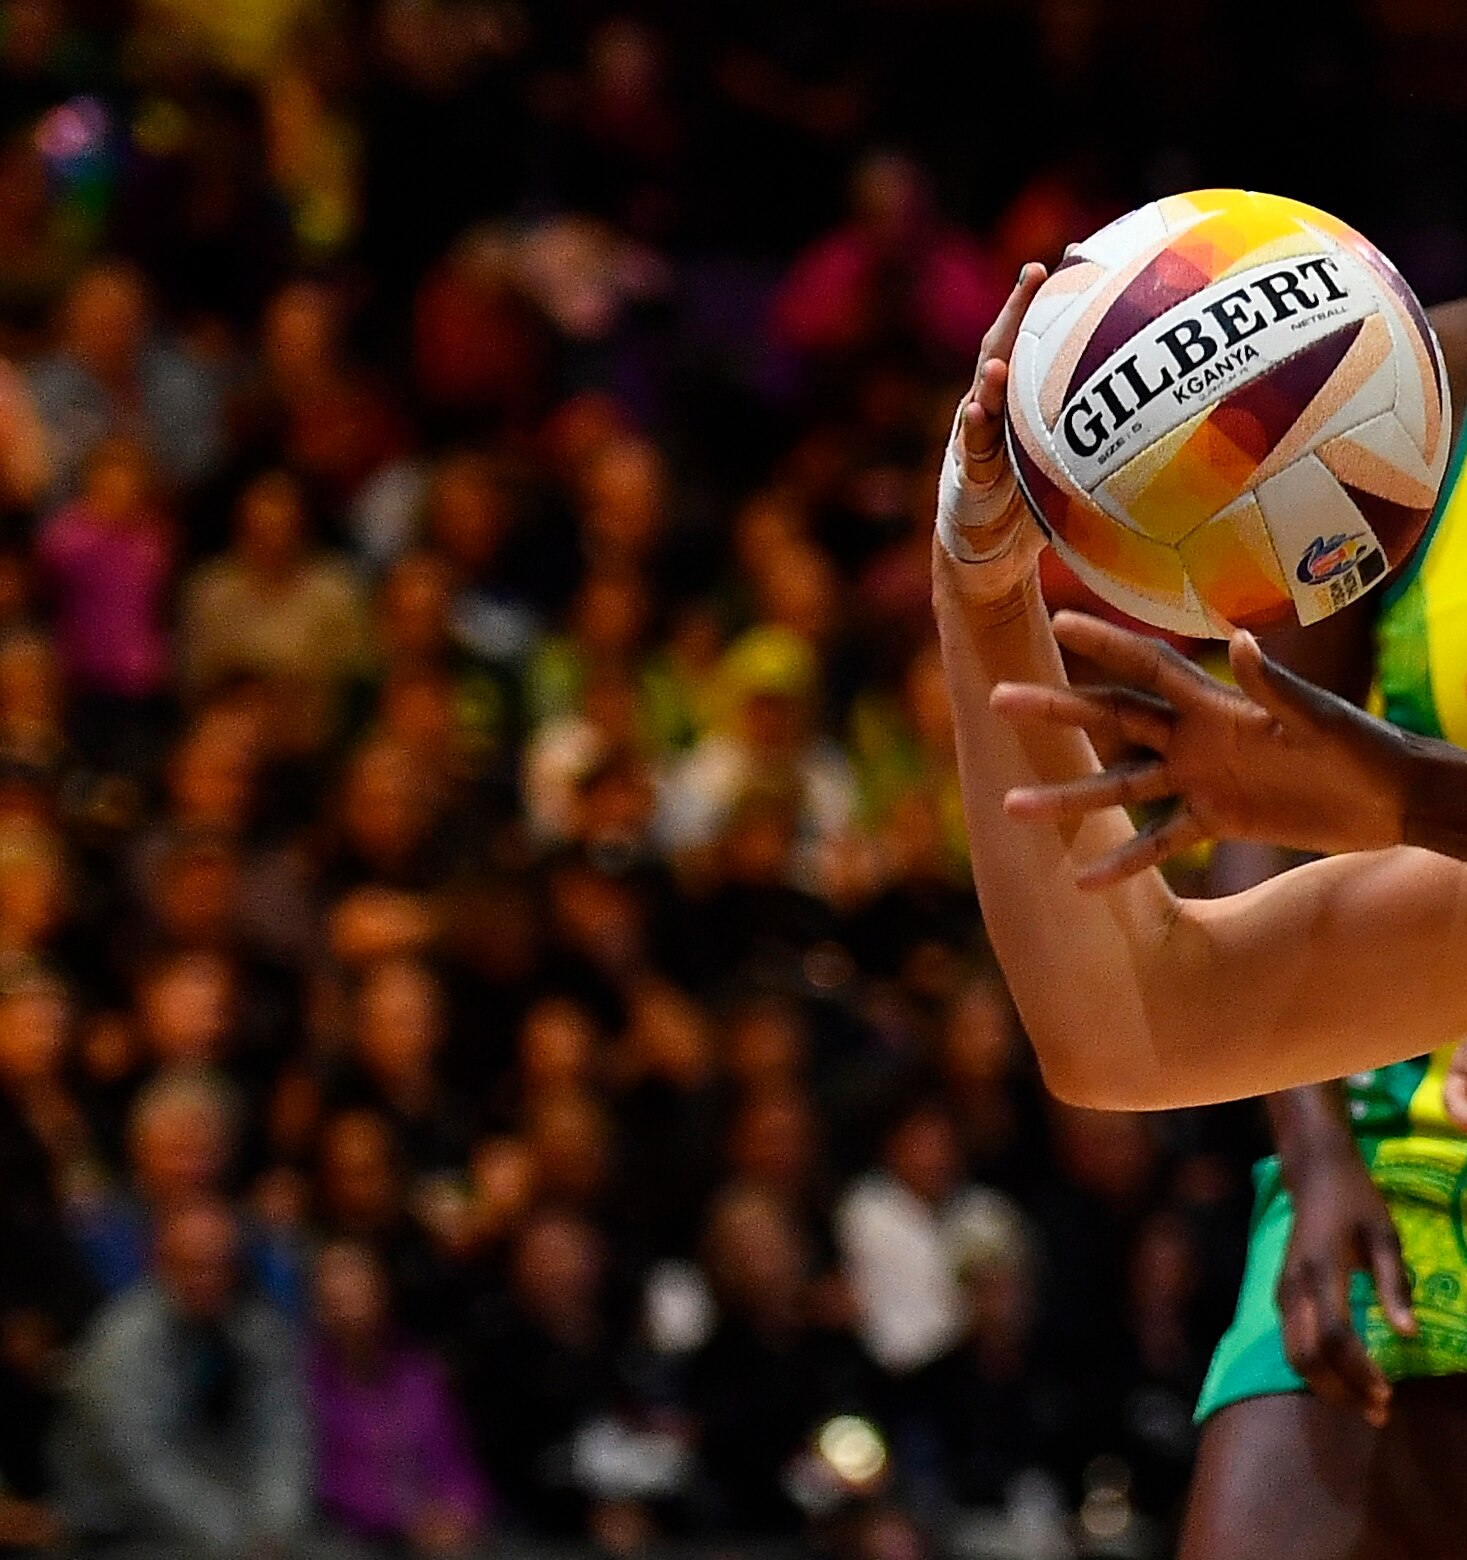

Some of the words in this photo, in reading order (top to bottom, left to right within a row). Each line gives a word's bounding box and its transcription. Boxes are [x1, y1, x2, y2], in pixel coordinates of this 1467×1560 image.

[1290, 305, 1349, 332] NETBALL
[1062, 256, 1349, 458] GILBERT
[1173, 344, 1260, 405] KGANYA
